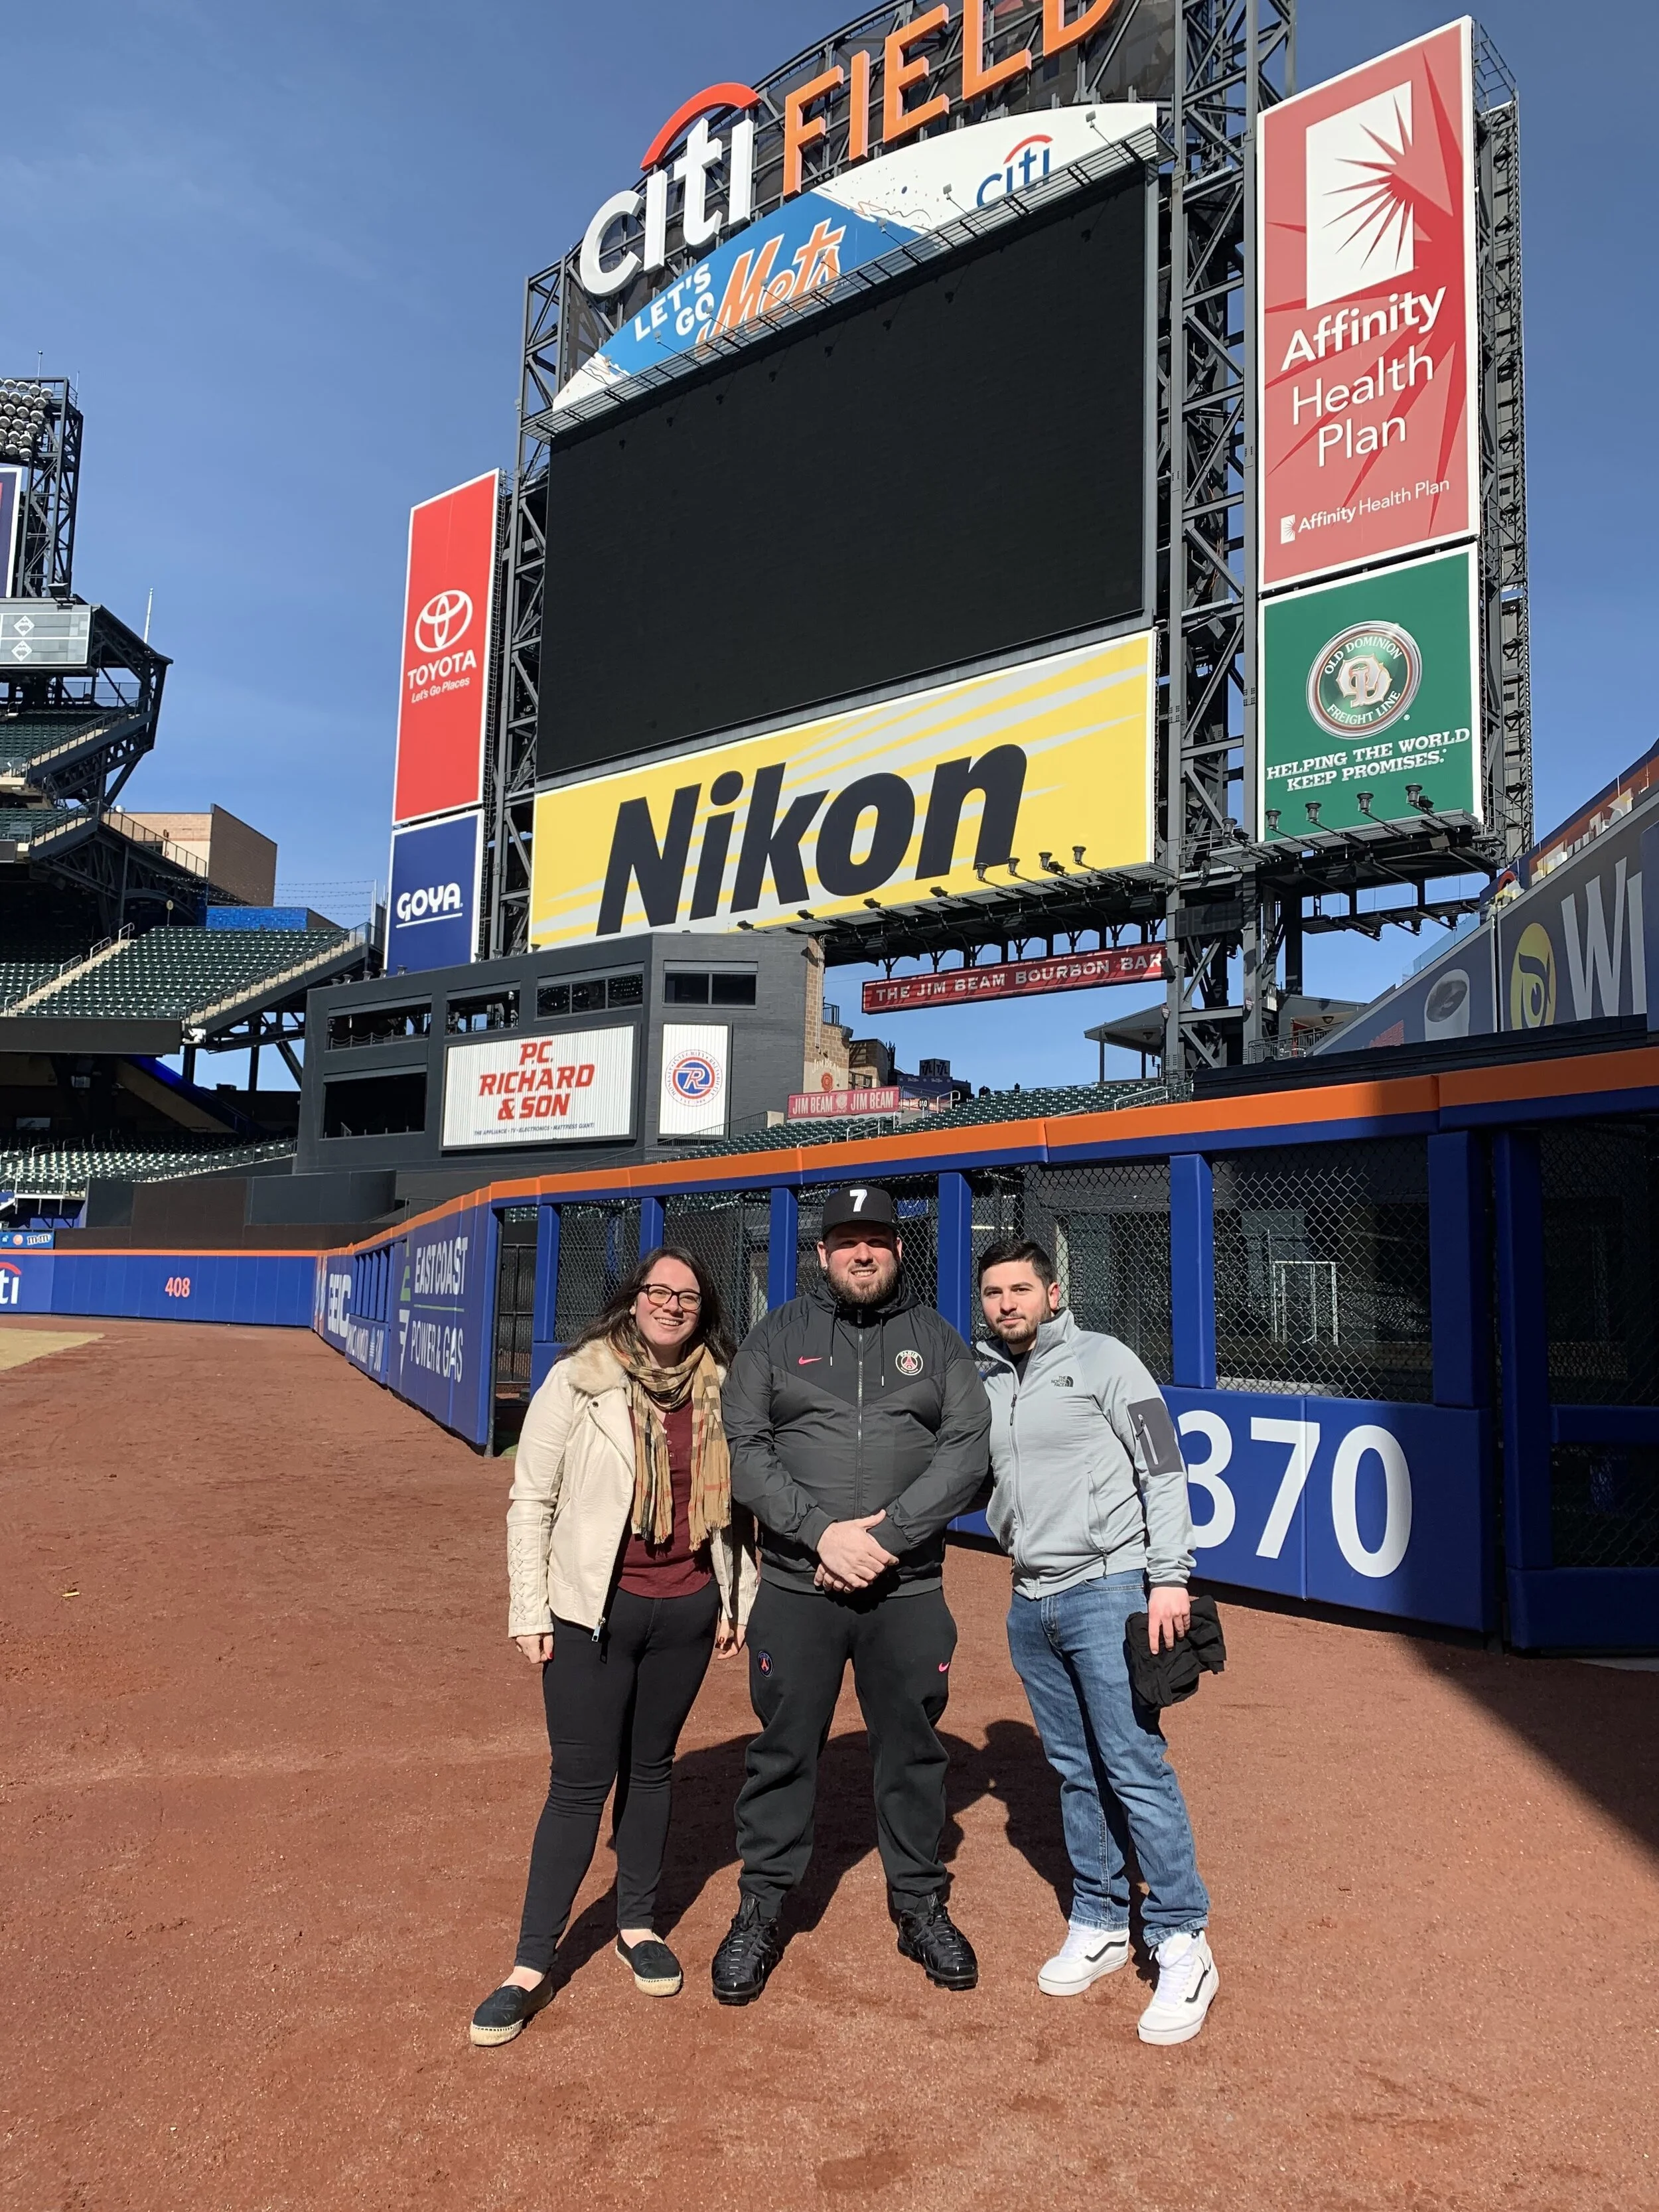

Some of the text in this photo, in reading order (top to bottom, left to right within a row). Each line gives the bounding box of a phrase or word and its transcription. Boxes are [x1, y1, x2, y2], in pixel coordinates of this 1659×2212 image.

[579, 117, 755, 296] citi
[634, 263, 712, 342] LET'S
[694, 217, 847, 359] Mets
[676, 292, 715, 336] GO
[1280, 286, 1447, 372] Affinity
[1293, 345, 1433, 425] Health
[1319, 415, 1407, 467] Plan
[1298, 479, 1450, 533] Affinity Health Plan
[407, 649, 477, 690] TOYOTA
[1325, 636, 1403, 674] OLD DOMINION
[411, 677, 470, 703] Let's Go Places
[1327, 690, 1401, 725] FREIGHT LINE
[1266, 727, 1470, 780] HELPING THE WORLD
[1287, 750, 1444, 792] KEEP PROMISES.
[595, 743, 1028, 937] Nikon
[397, 883, 461, 922] GOYA
[876, 952, 1162, 1001] THE JIM BEAM BOURBON BAR
[479, 1064, 595, 1096] RICHARD
[850, 1090, 894, 1111] JIM BEAM
[498, 1093, 571, 1121] & SON
[792, 1095, 833, 1115] JIM BEAM
[849, 1189, 867, 1213] 7
[0, 1268, 19, 1305] ti
[165, 1277, 191, 1298] 408
[328, 1273, 352, 1338] GEIC
[410, 1320, 436, 1372] POWER
[435, 1325, 441, 1374] &
[443, 1325, 464, 1383] GAS
[1177, 1410, 1413, 1578] 370
